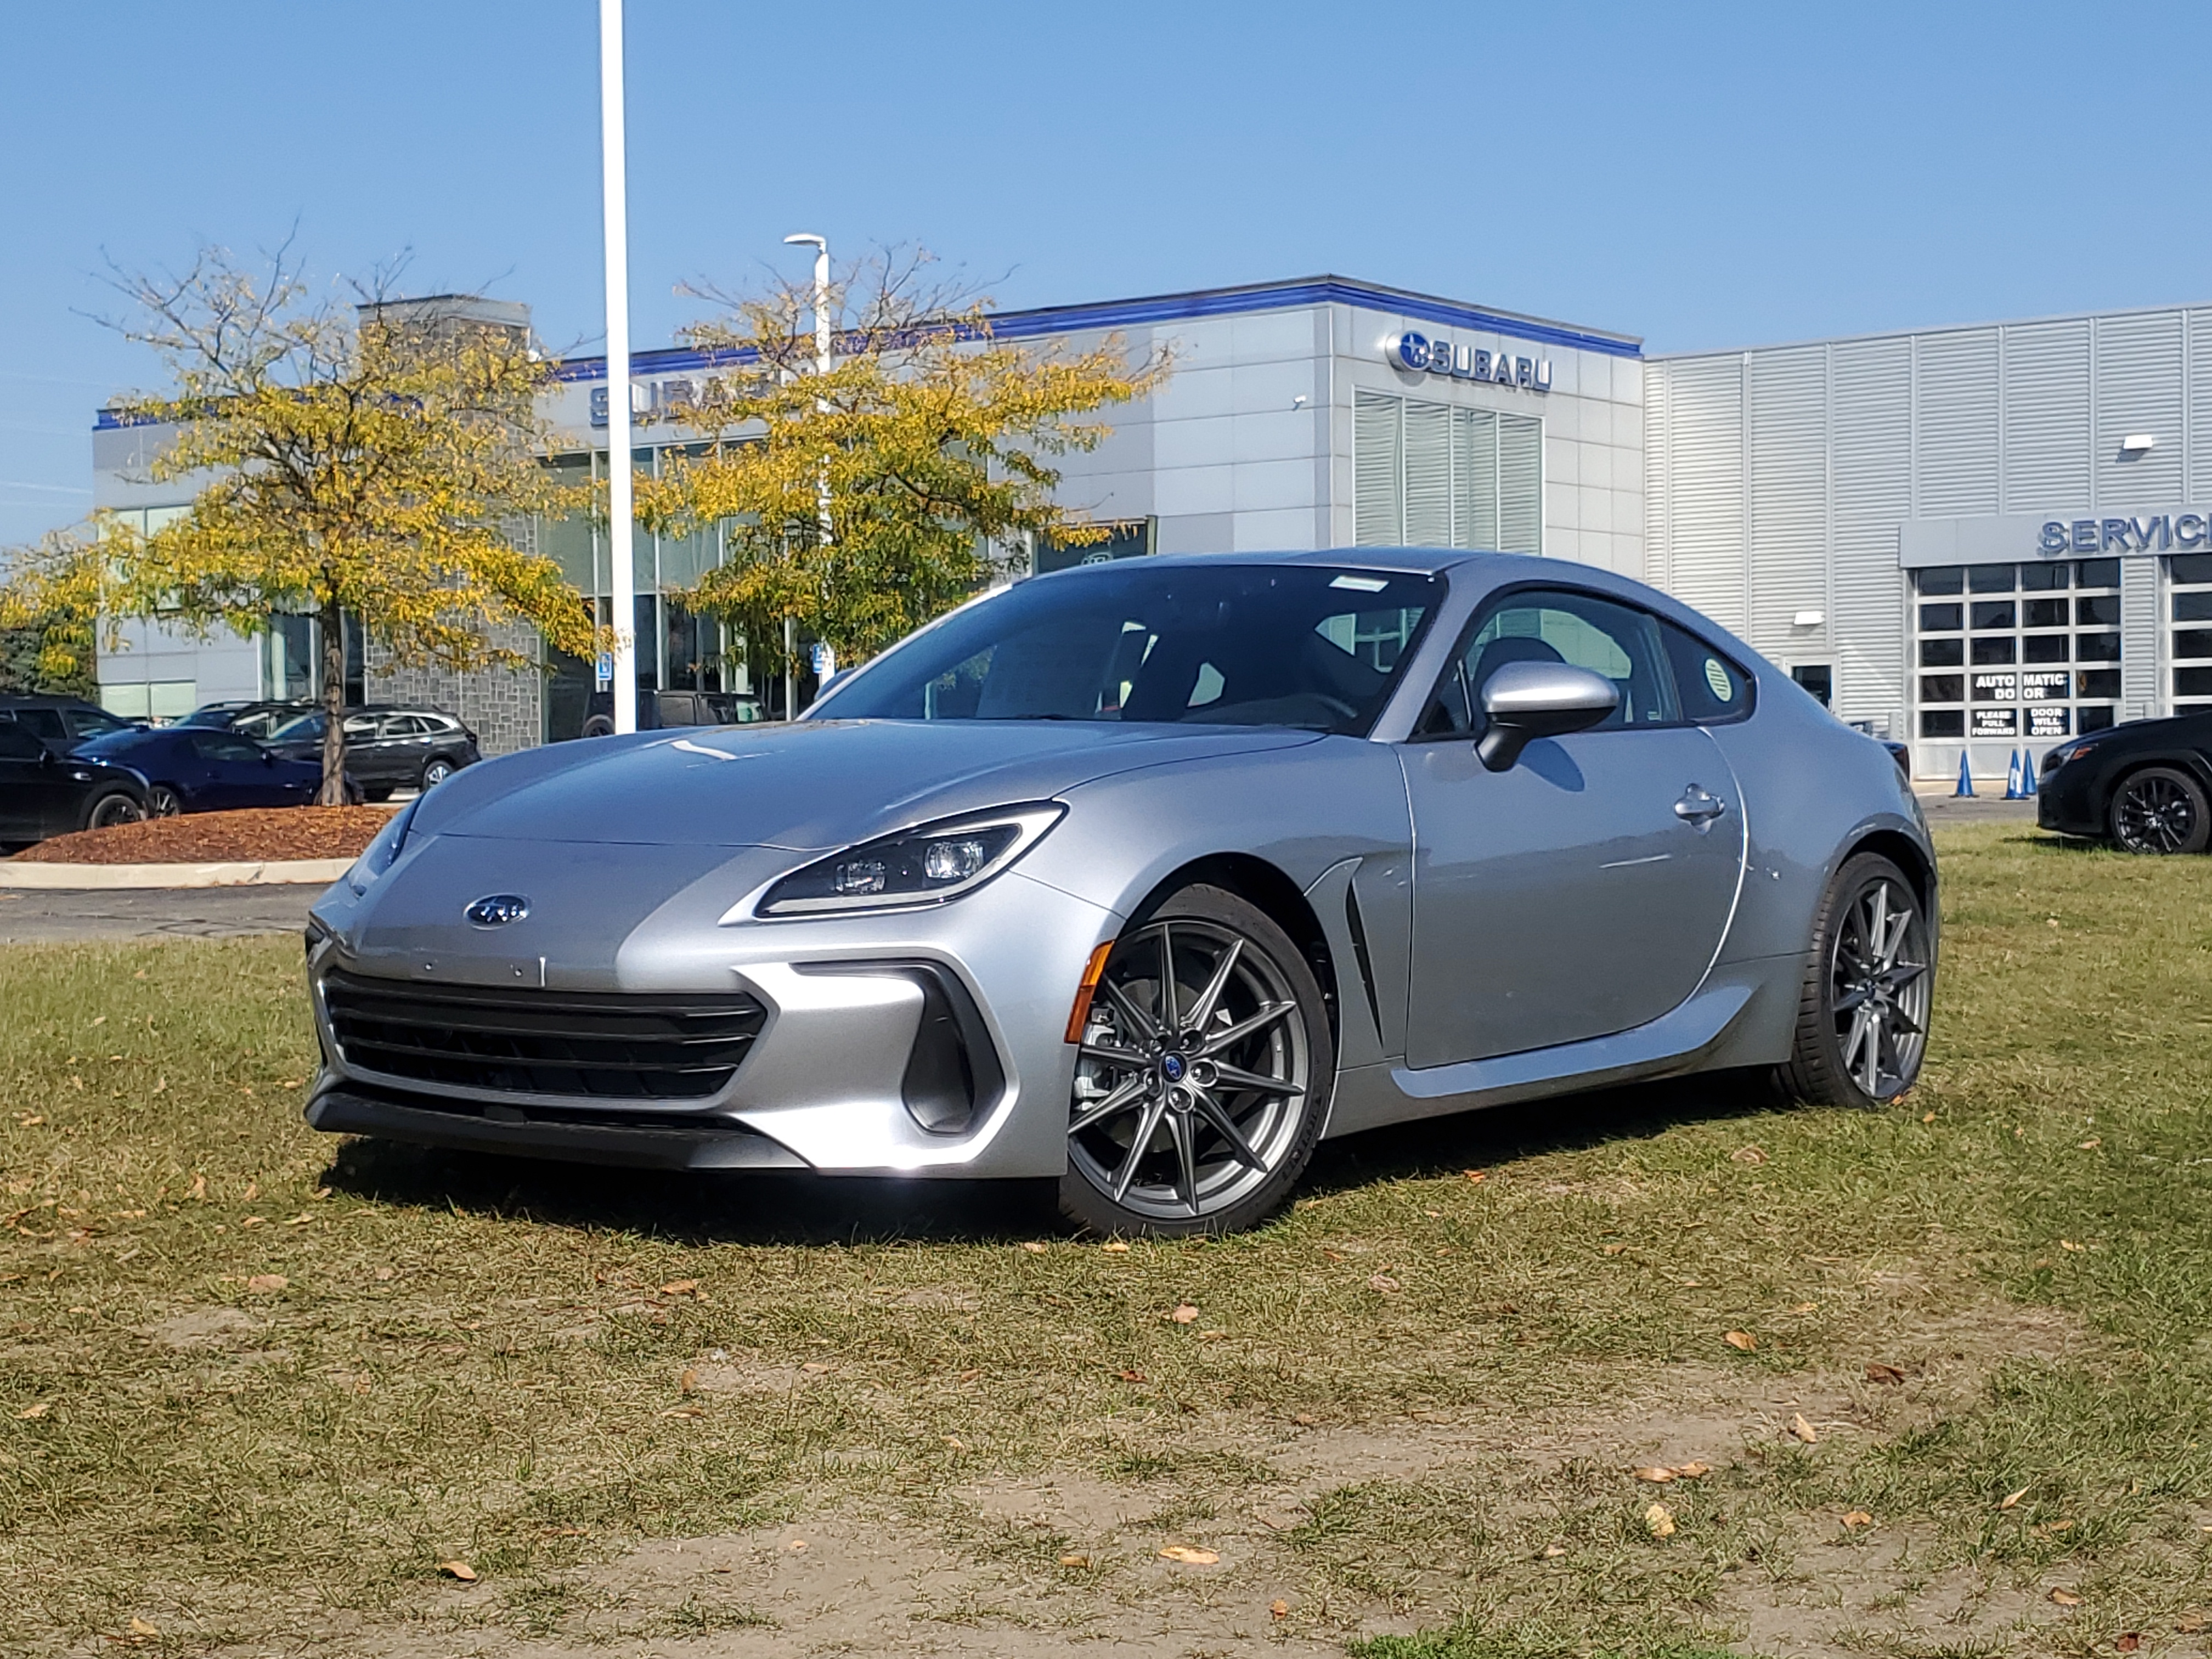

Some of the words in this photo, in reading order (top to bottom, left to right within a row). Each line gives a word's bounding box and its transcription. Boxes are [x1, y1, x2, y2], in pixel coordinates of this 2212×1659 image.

[1430, 340, 1552, 391] SUBARU
[2041, 514, 2212, 552] SERVIC
[1976, 710, 2011, 720] PLEASE
[2030, 708, 2062, 717] DOOR
[2033, 717, 2060, 726] WILL
[1972, 727, 2015, 736] FORWARD
[2031, 726, 2062, 736] OPEN
